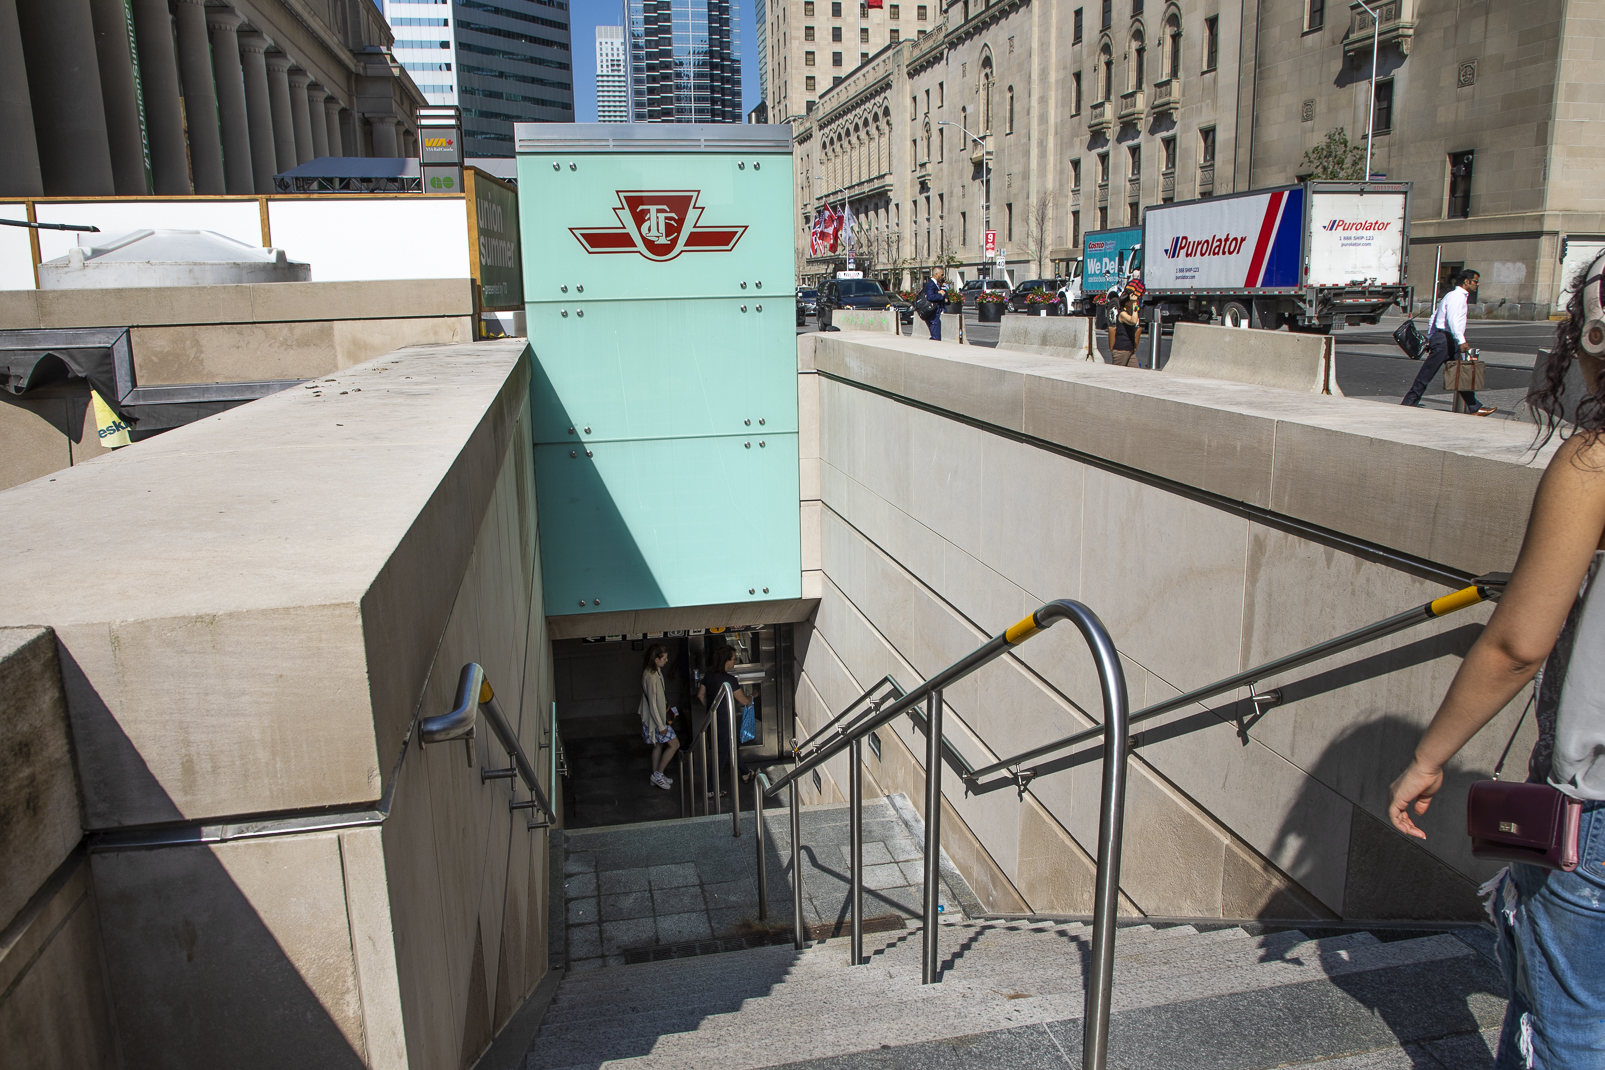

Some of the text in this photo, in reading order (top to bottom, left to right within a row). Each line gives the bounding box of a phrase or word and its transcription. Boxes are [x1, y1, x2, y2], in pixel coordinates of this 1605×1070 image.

[425, 138, 446, 147] VIA
[430, 176, 454, 189] GO
[477, 192, 503, 233] union
[636, 204, 679, 244] TTC
[1334, 219, 1391, 231] Purolator
[987, 233, 994, 242] 9
[1176, 233, 1247, 258] Purolator
[480, 236, 515, 268] summer
[1087, 258, 1101, 274] We
